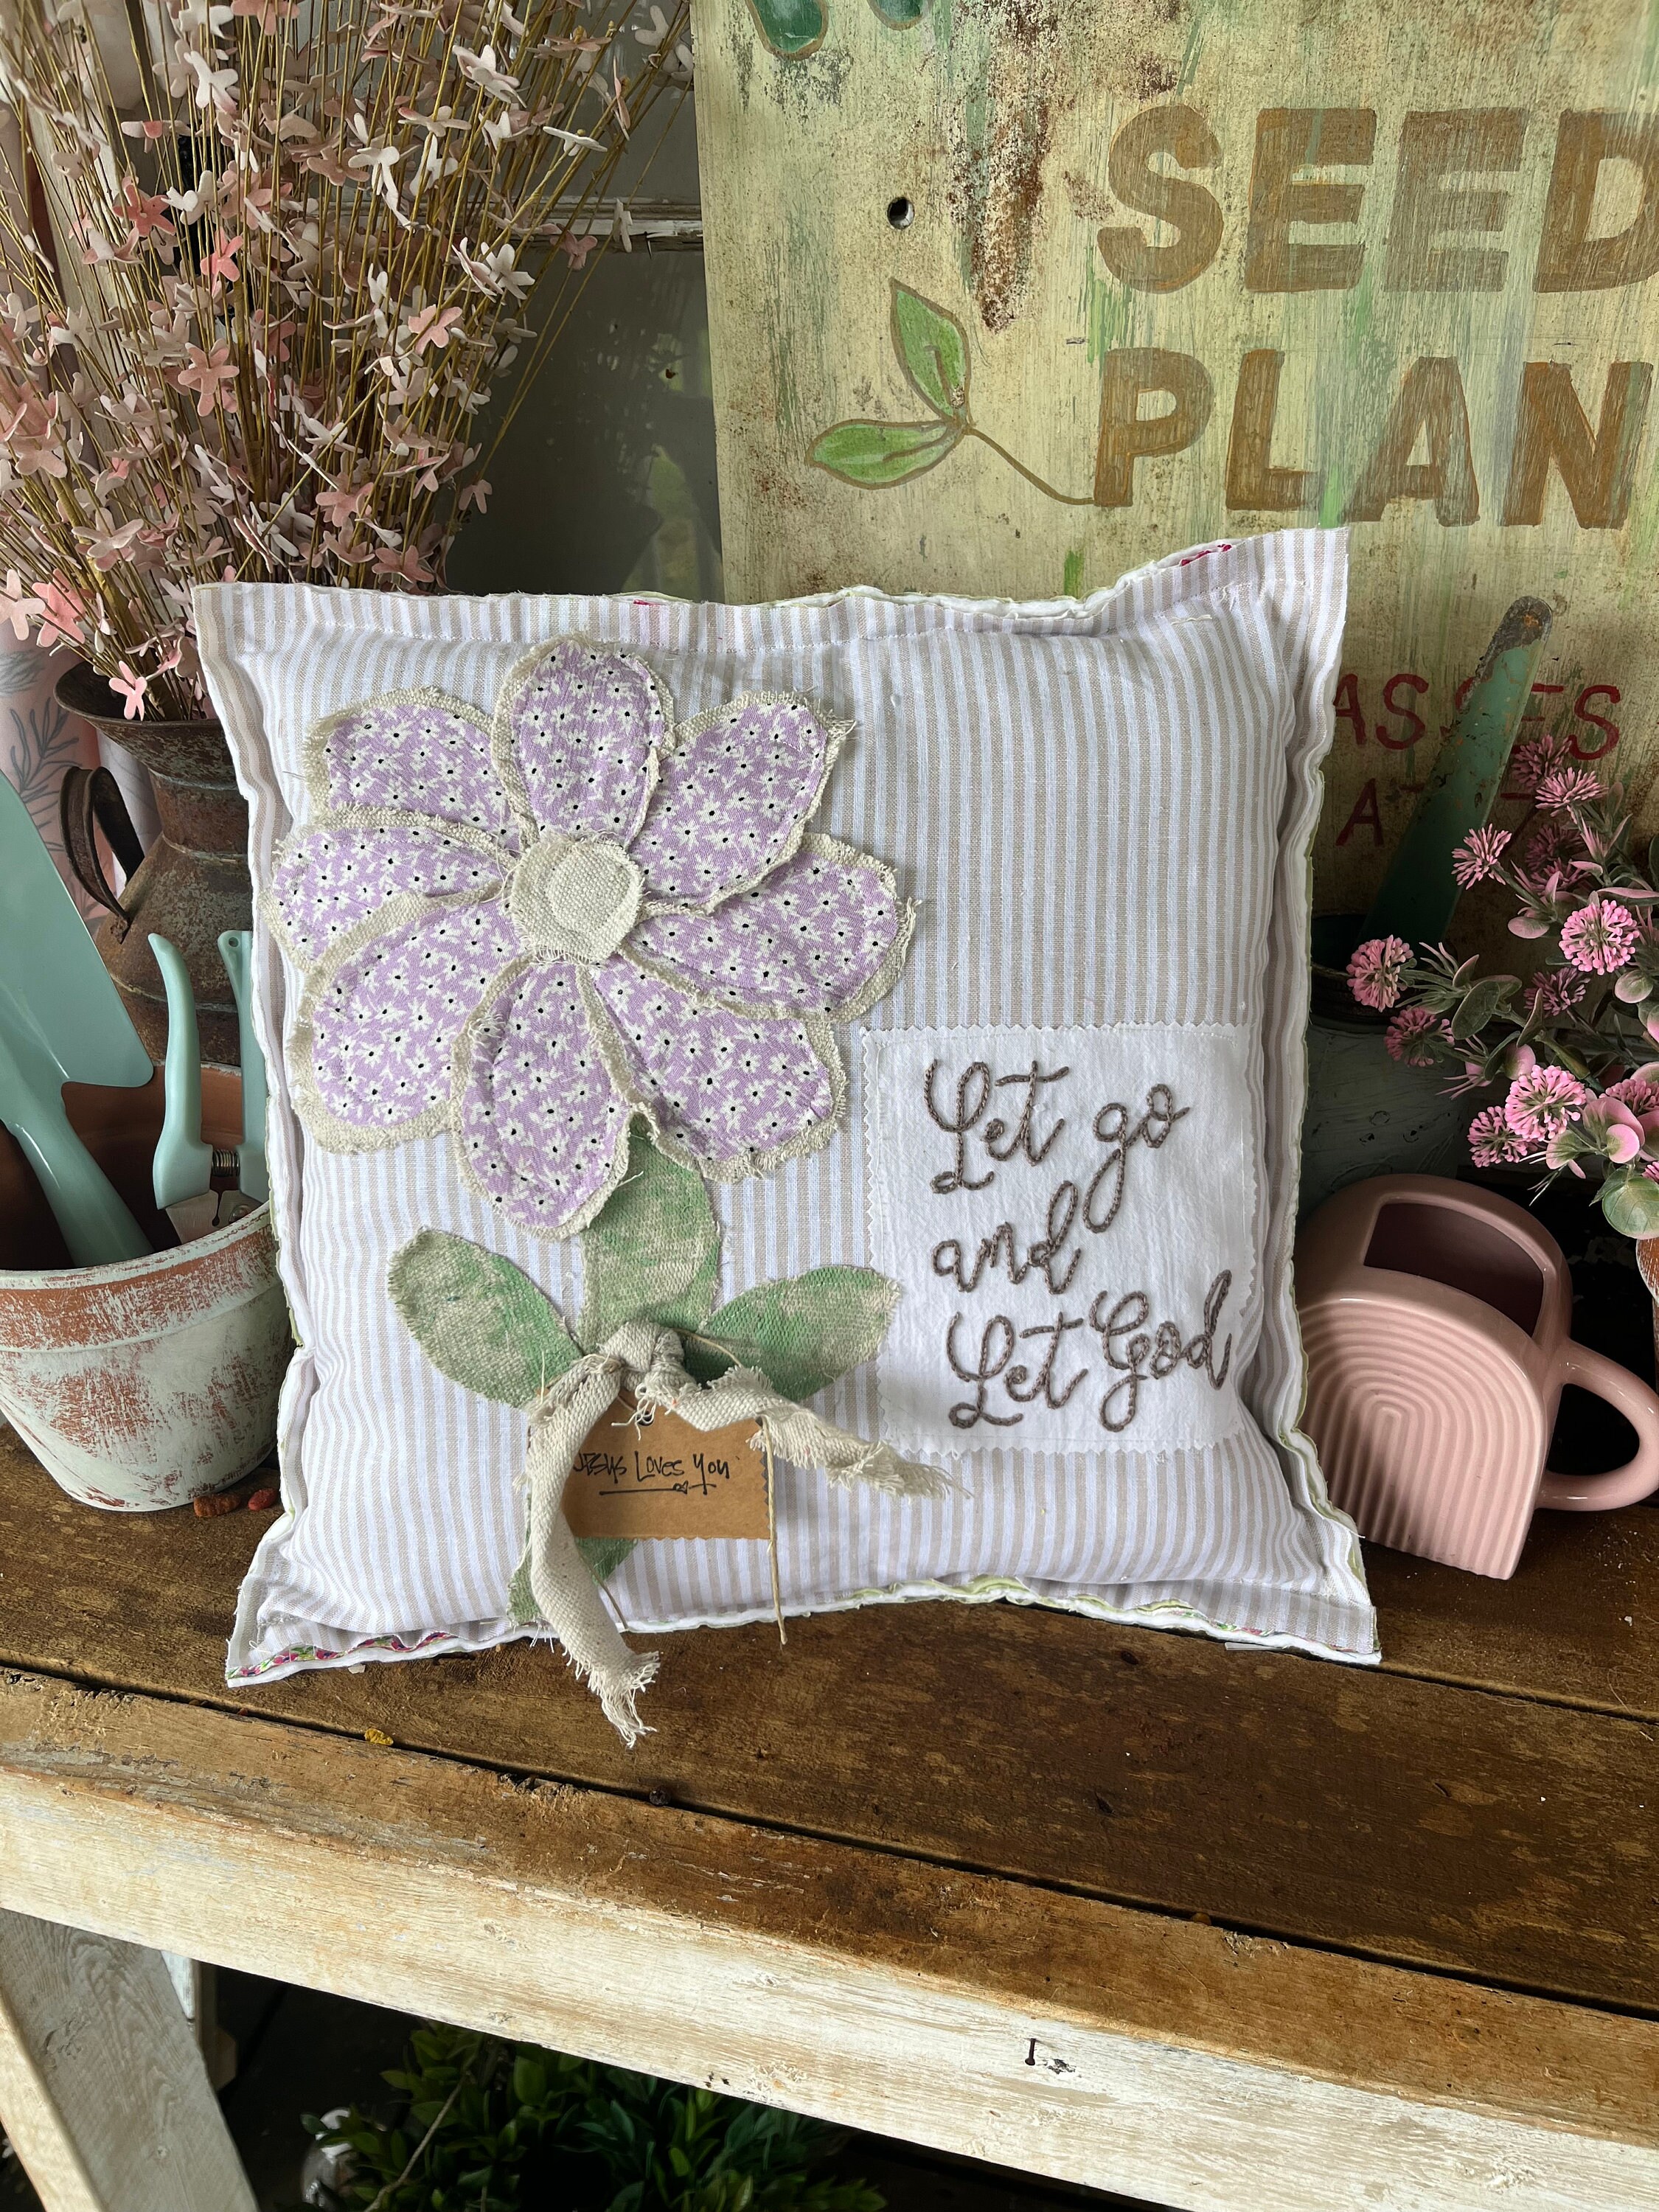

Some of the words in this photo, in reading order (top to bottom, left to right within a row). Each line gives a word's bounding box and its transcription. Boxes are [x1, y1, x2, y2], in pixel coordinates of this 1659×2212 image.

[1096, 104, 1659, 294] SEED
[1093, 347, 1654, 530] PLAN
[924, 1059, 1068, 1194] Let
[1083, 1083, 1190, 1233] go
[931, 1180, 1082, 1294] and
[947, 1310, 1088, 1429] Let
[1089, 1269, 1232, 1432] God
